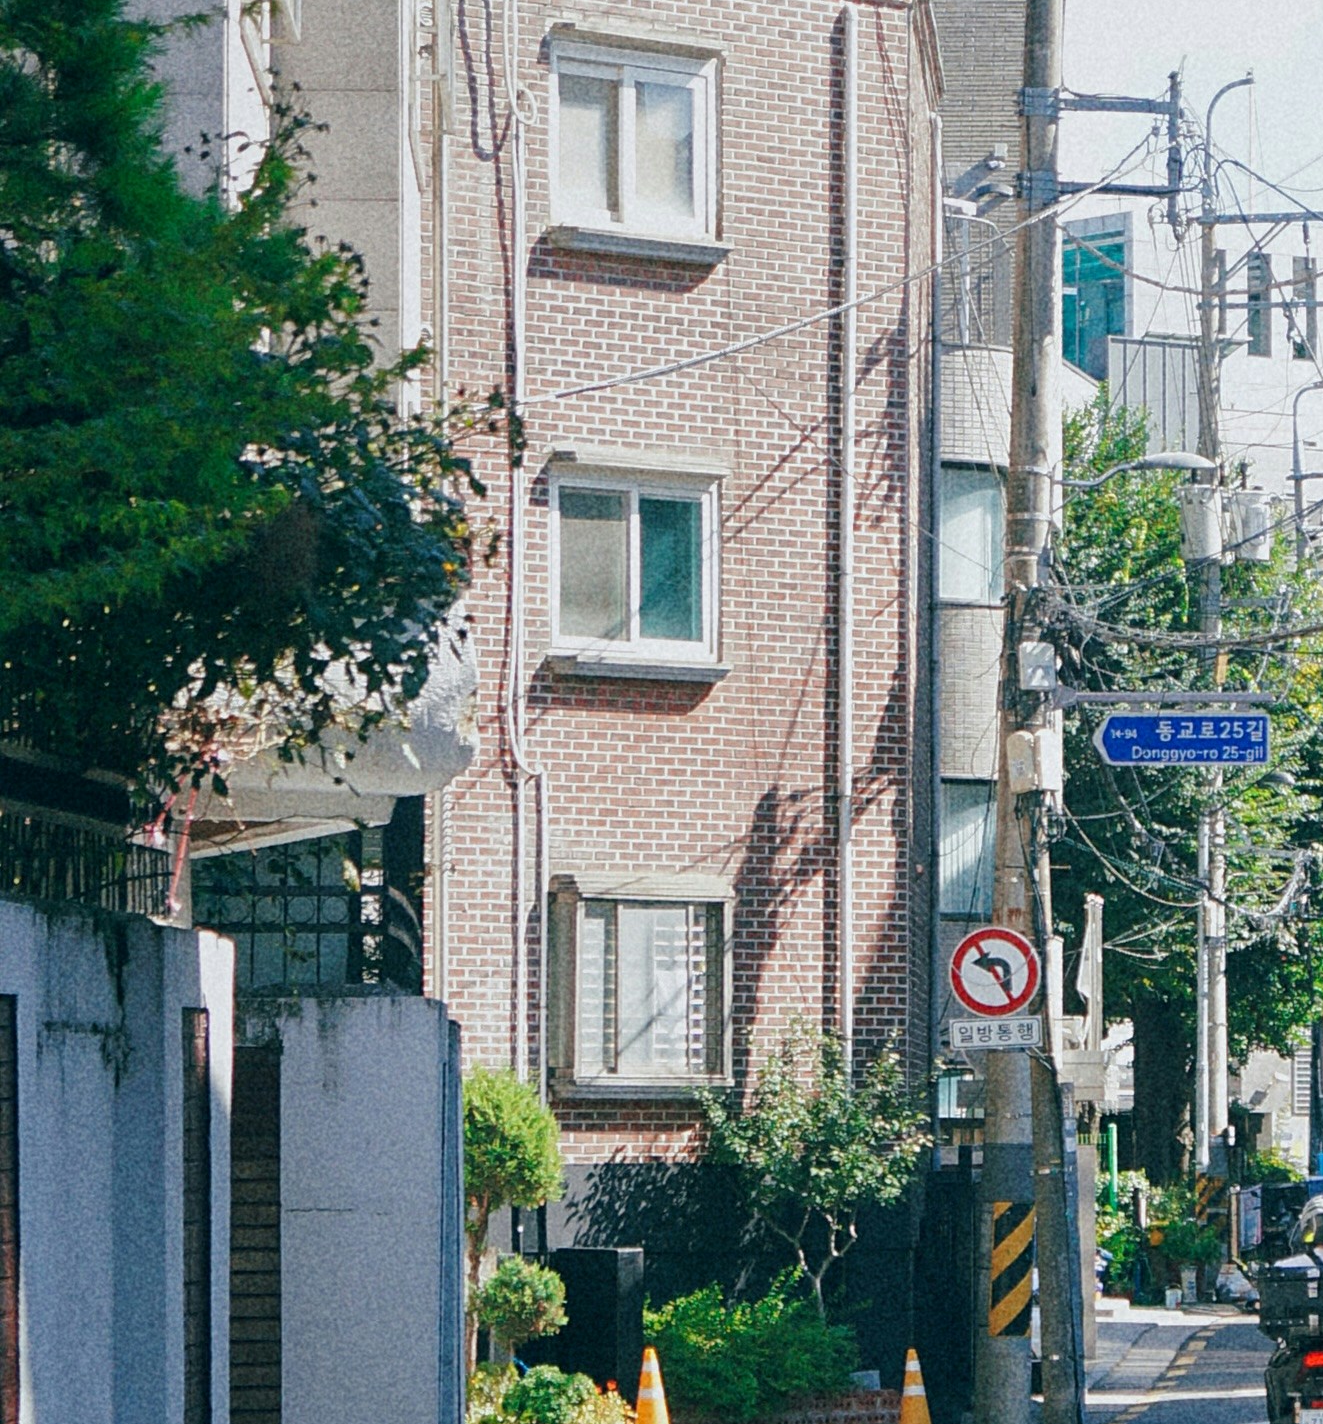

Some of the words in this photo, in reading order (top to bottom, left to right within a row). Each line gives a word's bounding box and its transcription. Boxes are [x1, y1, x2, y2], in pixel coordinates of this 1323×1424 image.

[1155, 719, 1264, 742] 동교로25길
[1131, 745, 1219, 762] Donggyo-ro
[1221, 745, 1264, 762] 25-gil
[958, 1022, 1034, 1044] 일방통행
